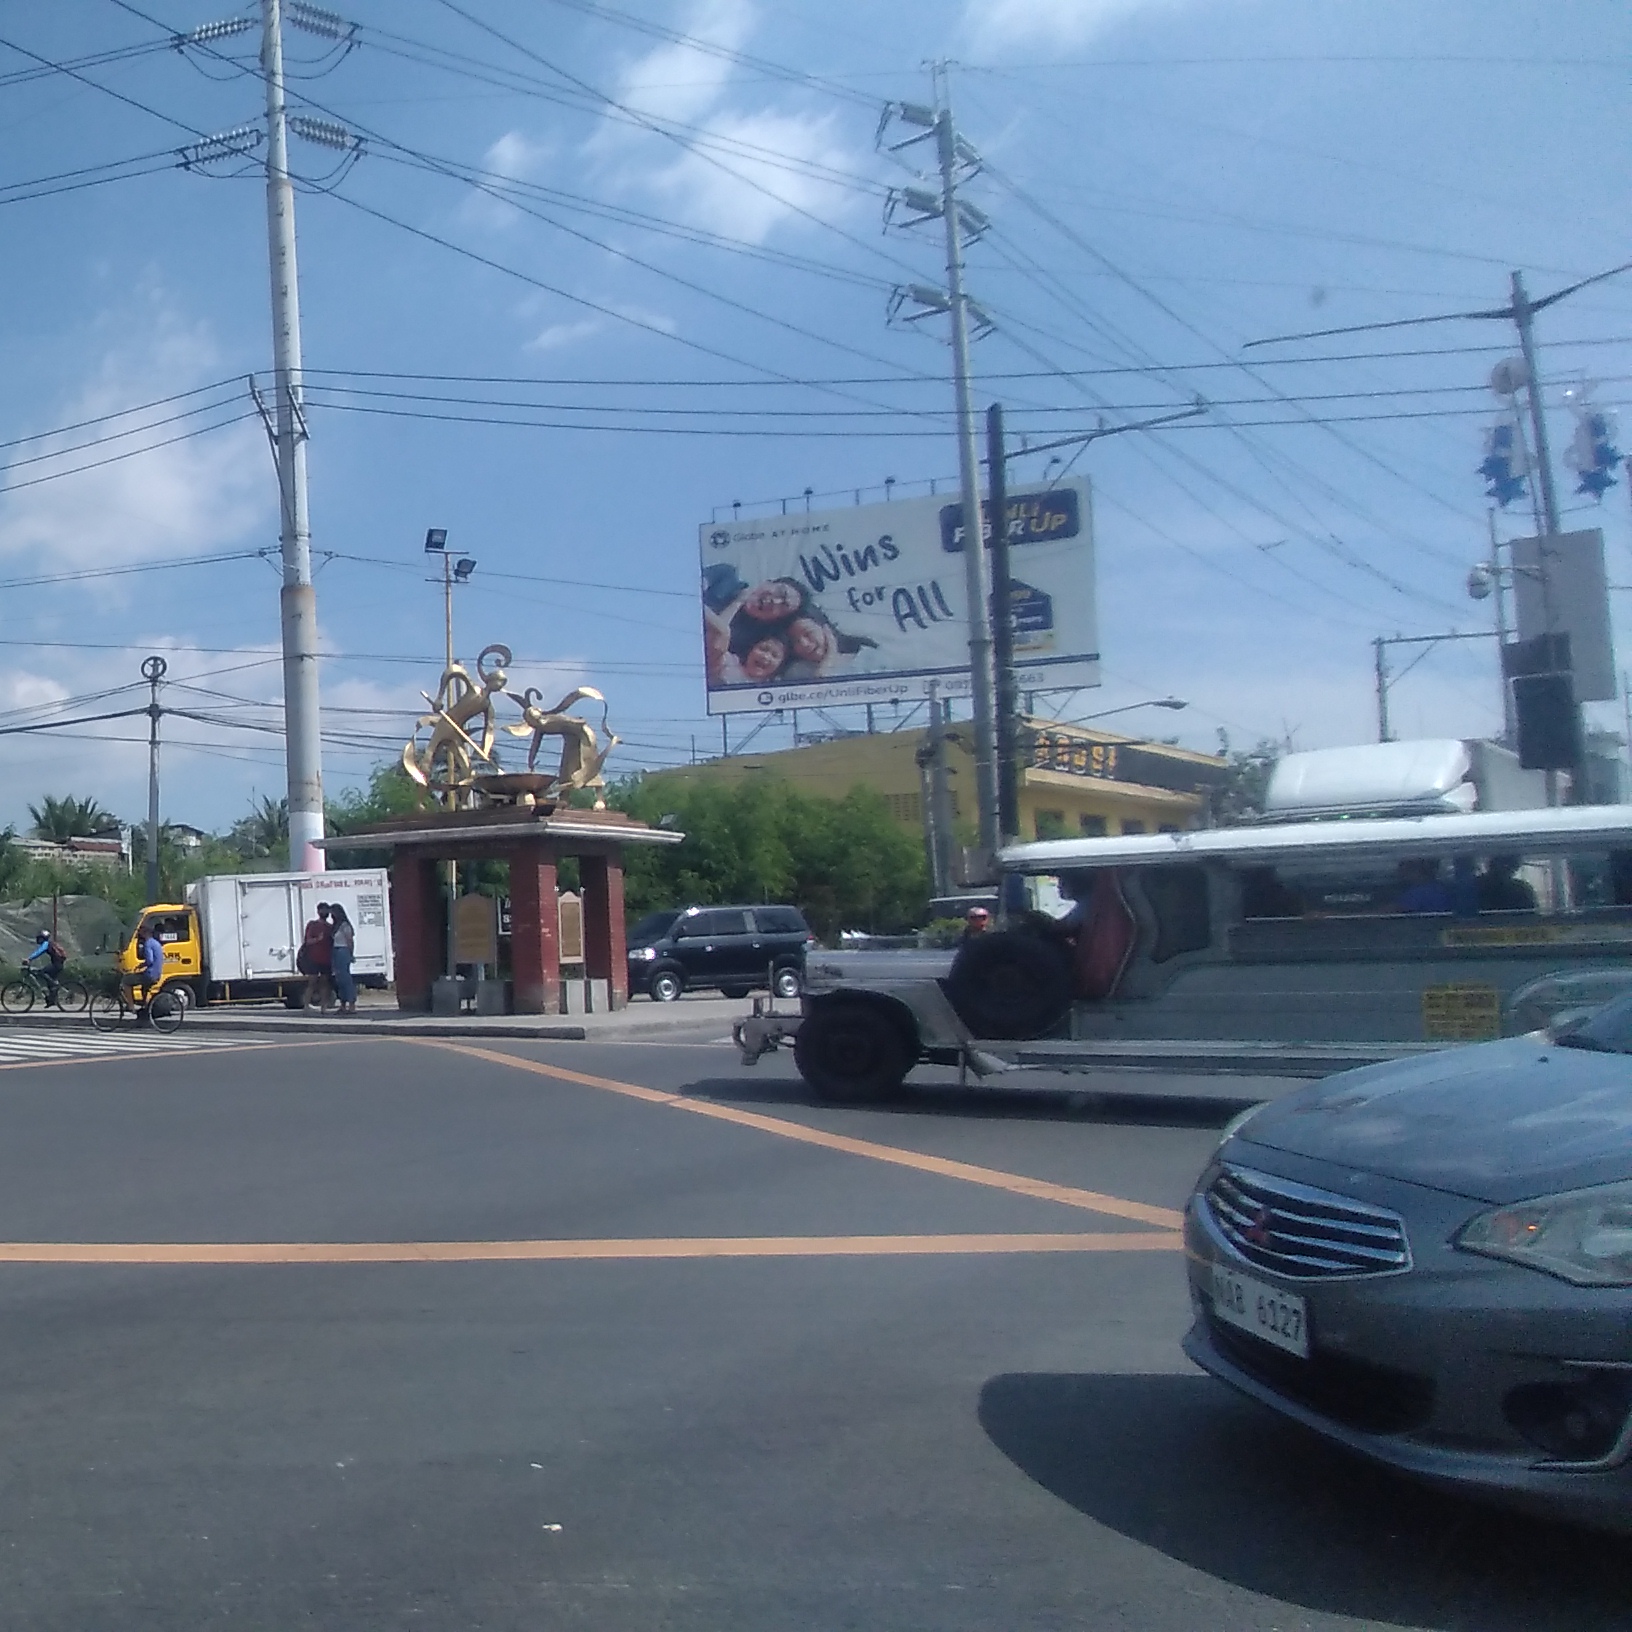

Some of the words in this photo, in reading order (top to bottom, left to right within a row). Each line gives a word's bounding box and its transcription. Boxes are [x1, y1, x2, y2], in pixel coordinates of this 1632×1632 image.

[799, 534, 900, 593] Wins
[847, 586, 886, 613] for
[892, 580, 954, 633] All
